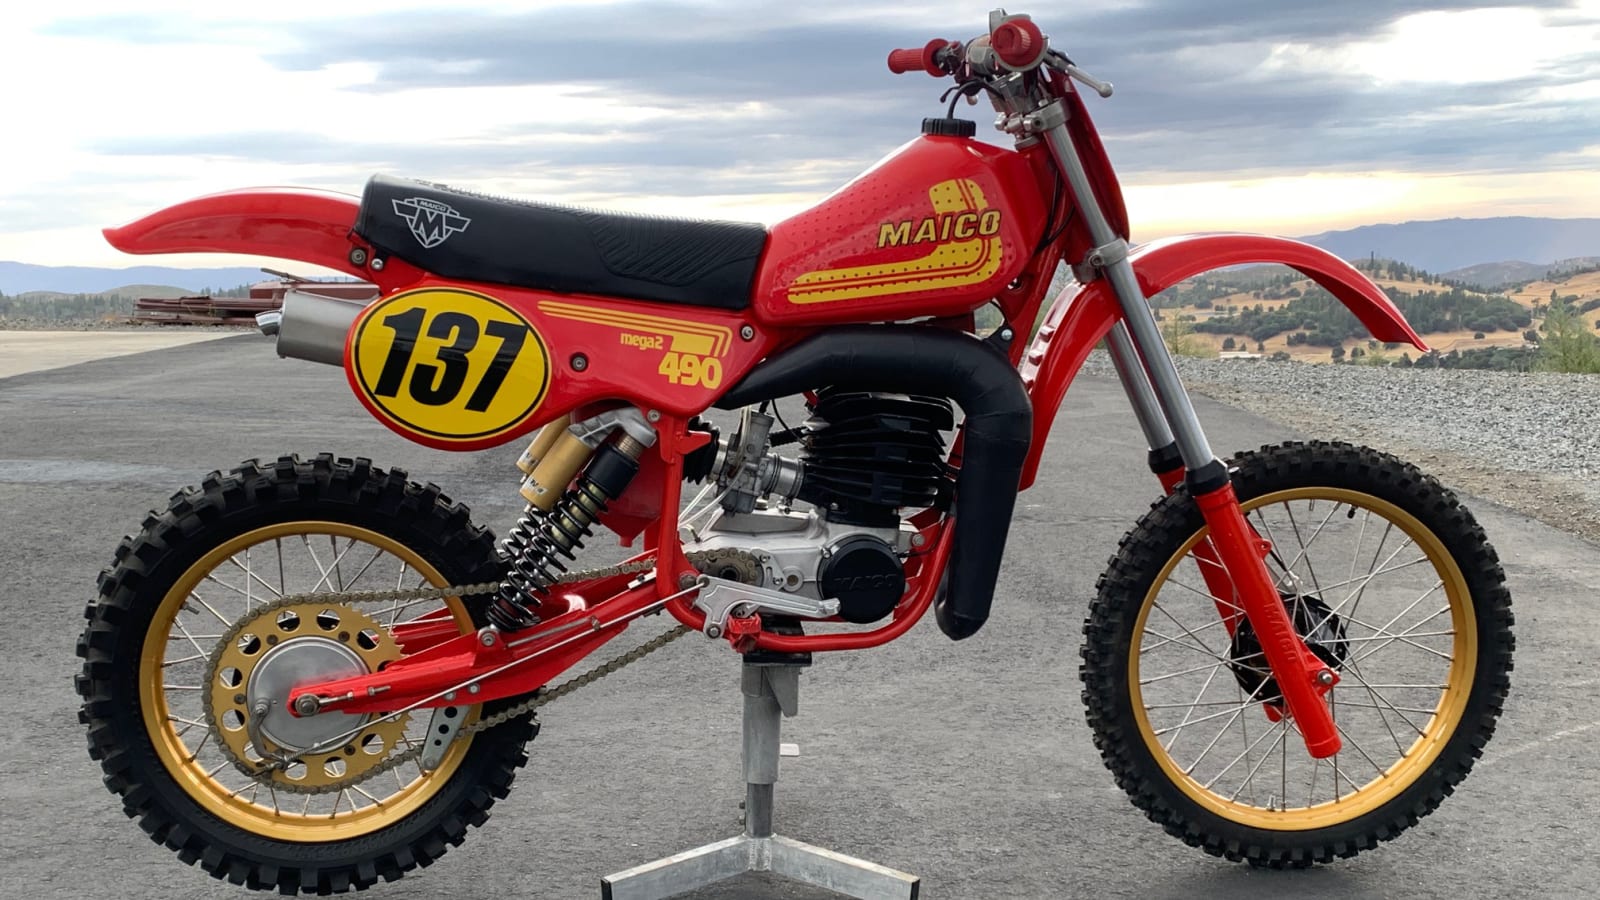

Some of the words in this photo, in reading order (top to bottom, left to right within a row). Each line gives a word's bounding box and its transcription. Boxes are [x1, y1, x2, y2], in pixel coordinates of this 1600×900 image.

[877, 209, 1002, 249] MAICO
[374, 307, 529, 413] 137
[620, 332, 664, 351] mega2
[658, 351, 723, 390] 490
